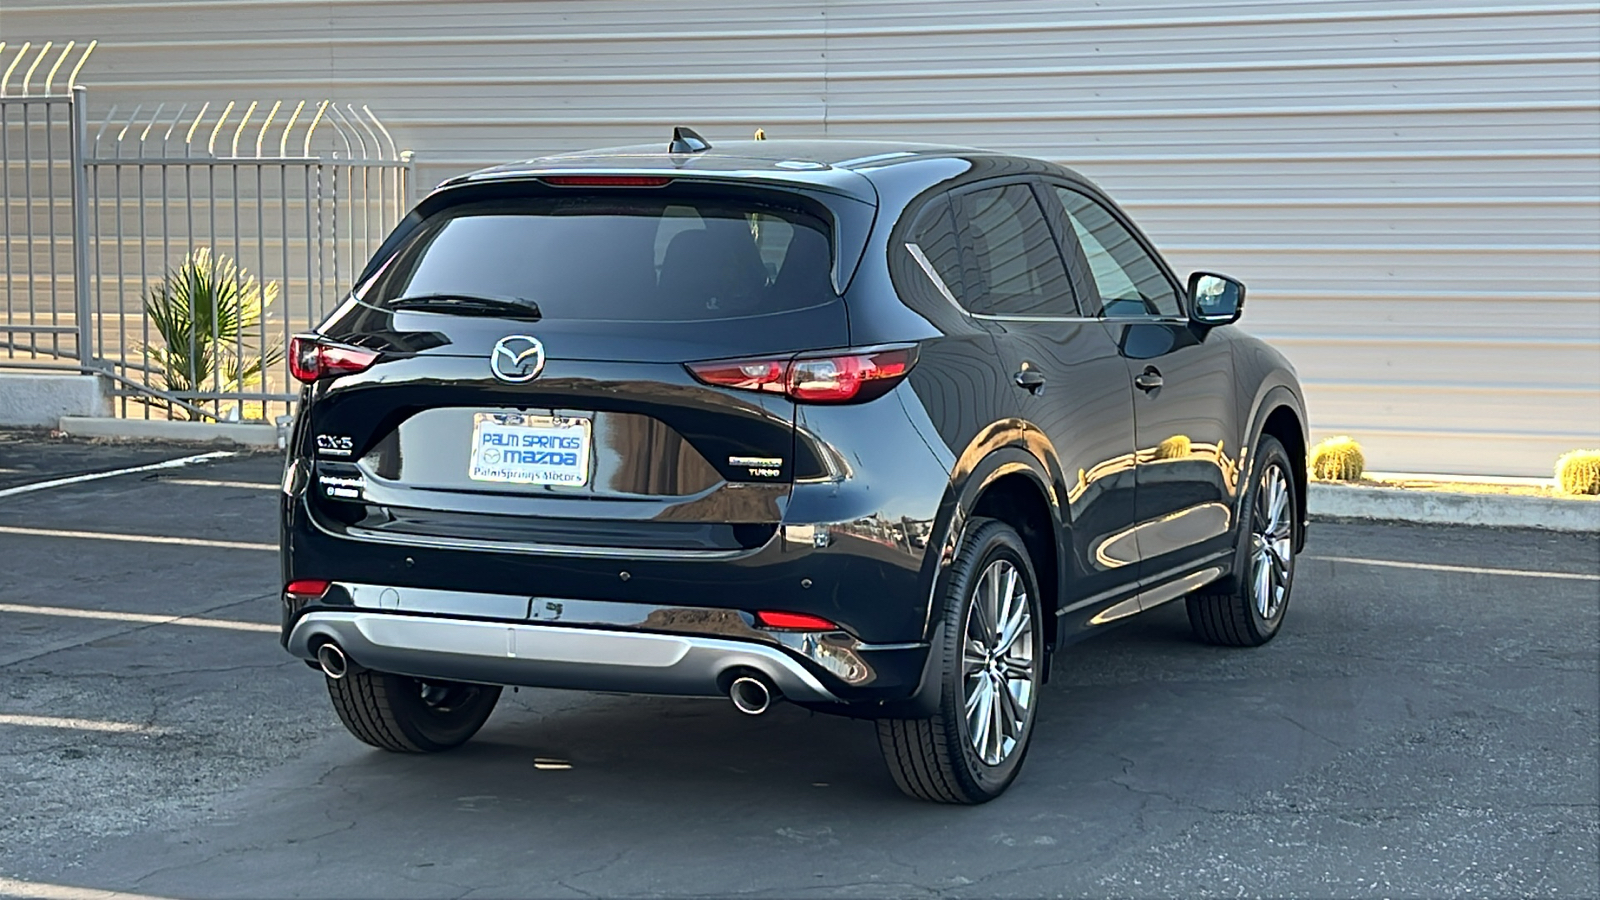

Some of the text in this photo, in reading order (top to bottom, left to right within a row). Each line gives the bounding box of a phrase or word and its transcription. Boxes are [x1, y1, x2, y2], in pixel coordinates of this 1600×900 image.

[316, 434, 354, 449] CX-5
[522, 435, 580, 450] SPRINGS
[748, 468, 780, 477] TURBO
